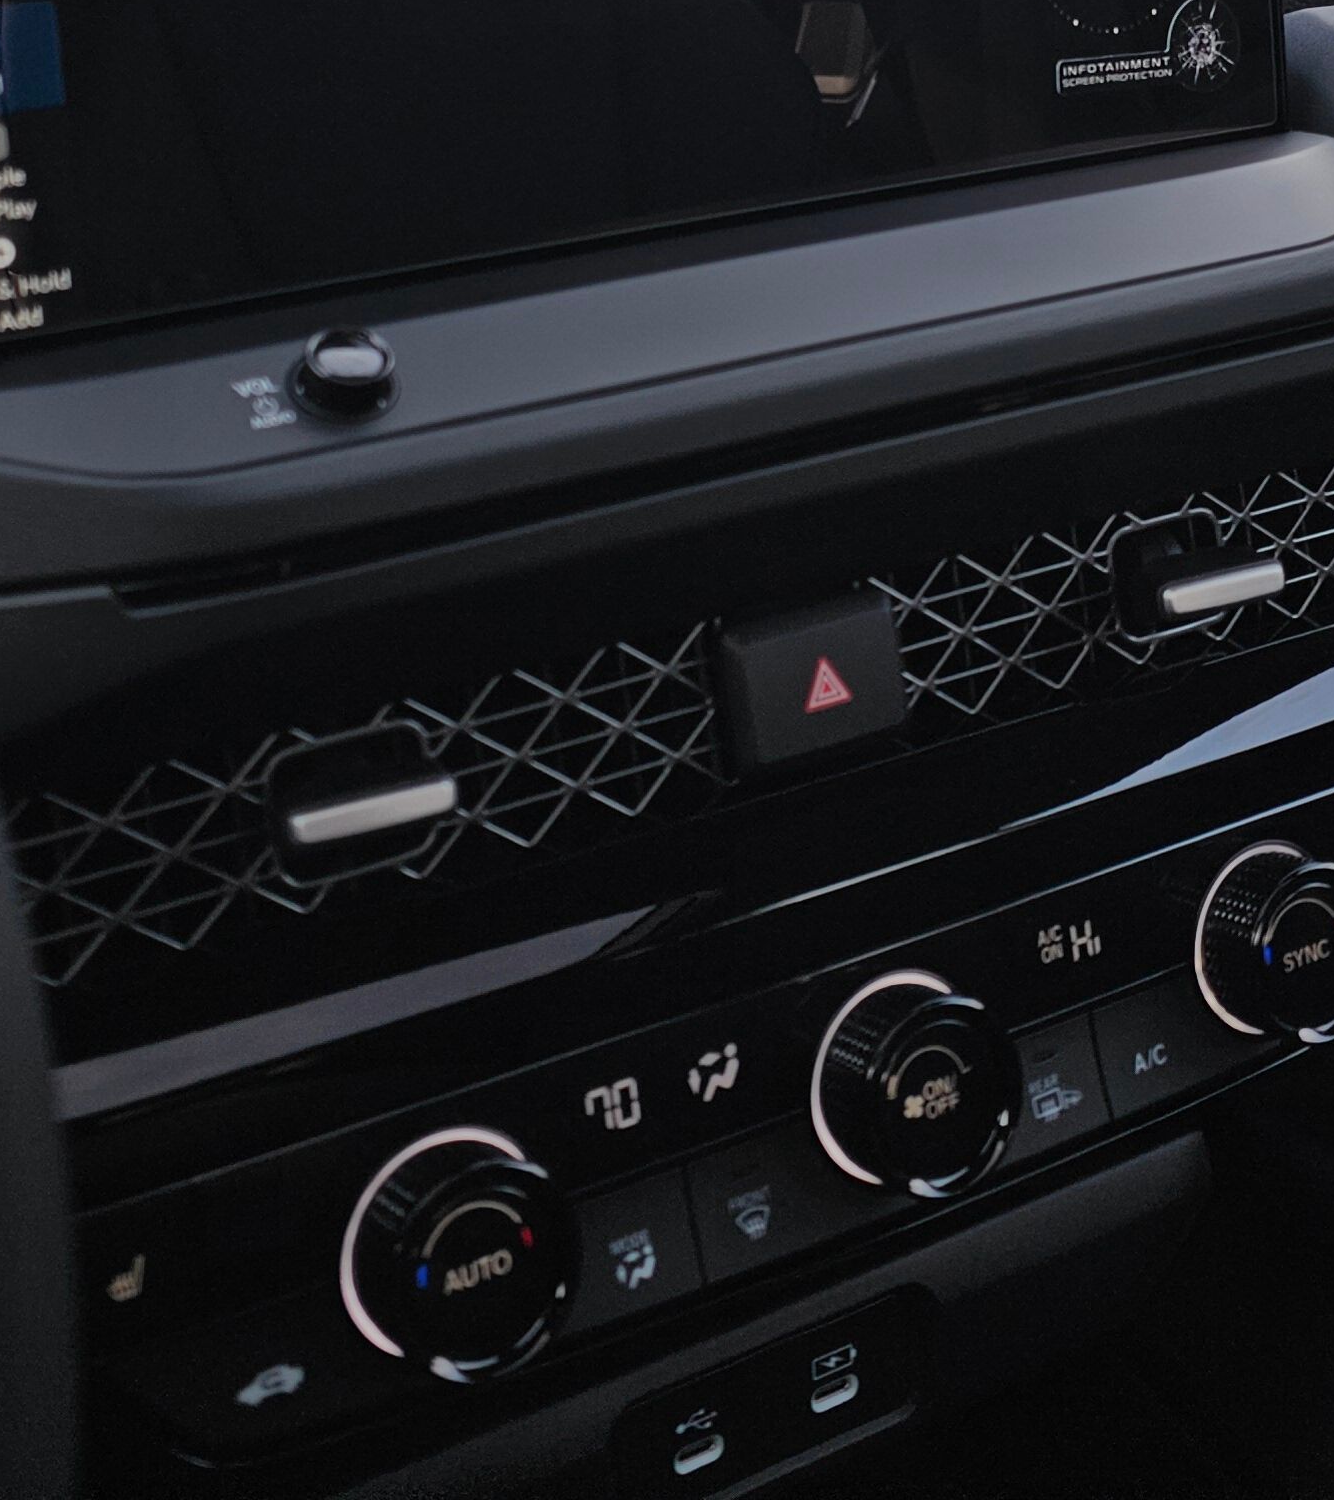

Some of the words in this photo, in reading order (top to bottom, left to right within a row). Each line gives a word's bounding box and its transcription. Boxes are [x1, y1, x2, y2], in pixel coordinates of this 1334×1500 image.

[1061, 73, 1105, 88] SCREEN
[1106, 67, 1173, 83] PROTECTION
[1062, 56, 1171, 77] INFOTAINMENT
[18, 267, 72, 297] Hold
[1037, 923, 1065, 947] A/C
[1040, 942, 1065, 965] ON
[1281, 937, 1333, 974] SYNC
[1133, 1043, 1168, 1076] A/C
[584, 1076, 643, 1131] 70
[443, 1248, 514, 1297] AUTO
